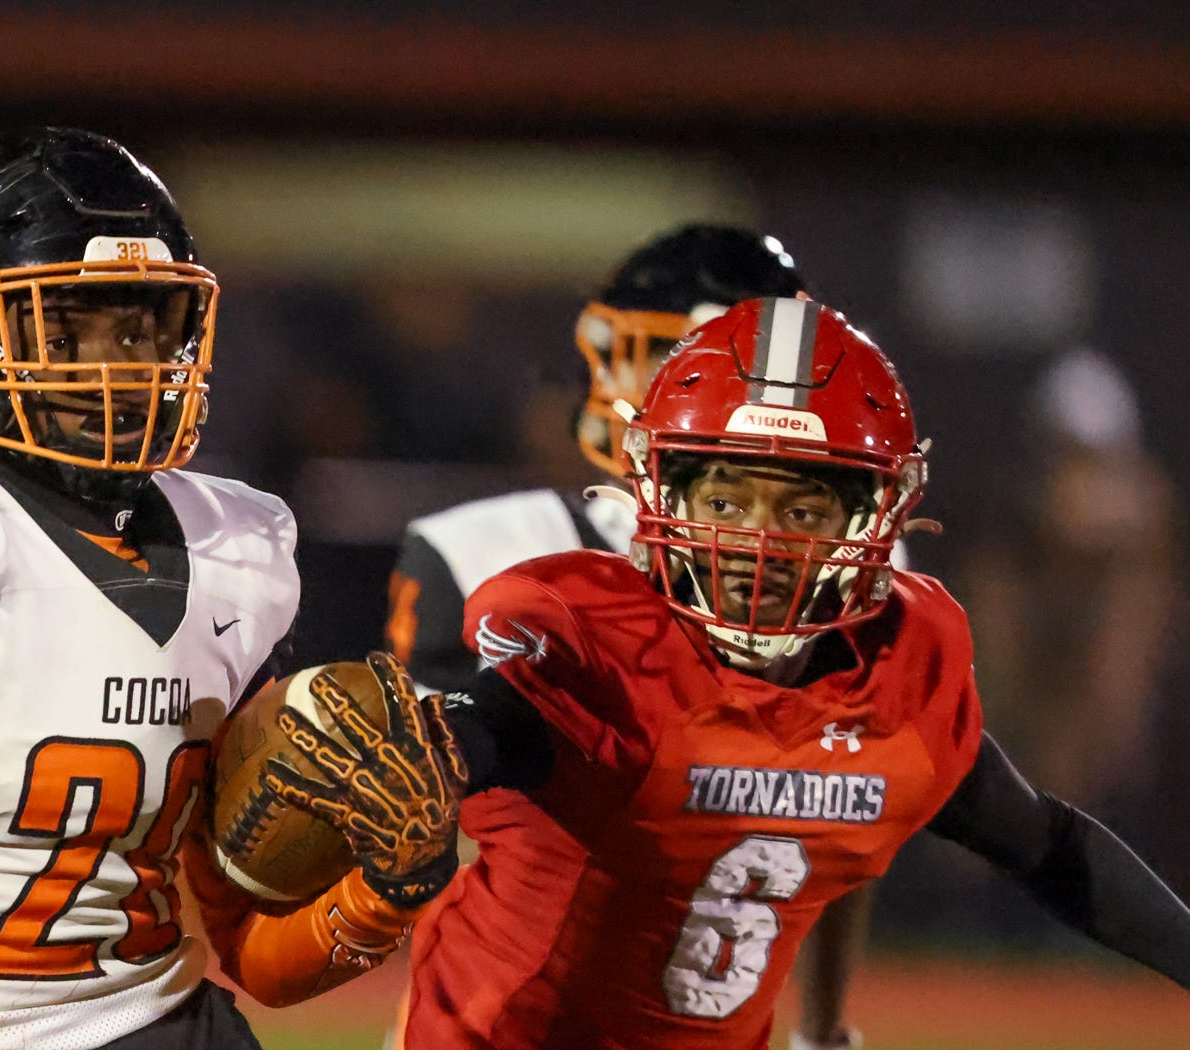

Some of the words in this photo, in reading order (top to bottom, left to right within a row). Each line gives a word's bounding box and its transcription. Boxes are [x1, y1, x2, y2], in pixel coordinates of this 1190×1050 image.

[116, 242, 150, 261] 321
[102, 677, 192, 726] COCOA
[686, 766, 886, 823] TORNADOES
[661, 834, 811, 1019] 6
